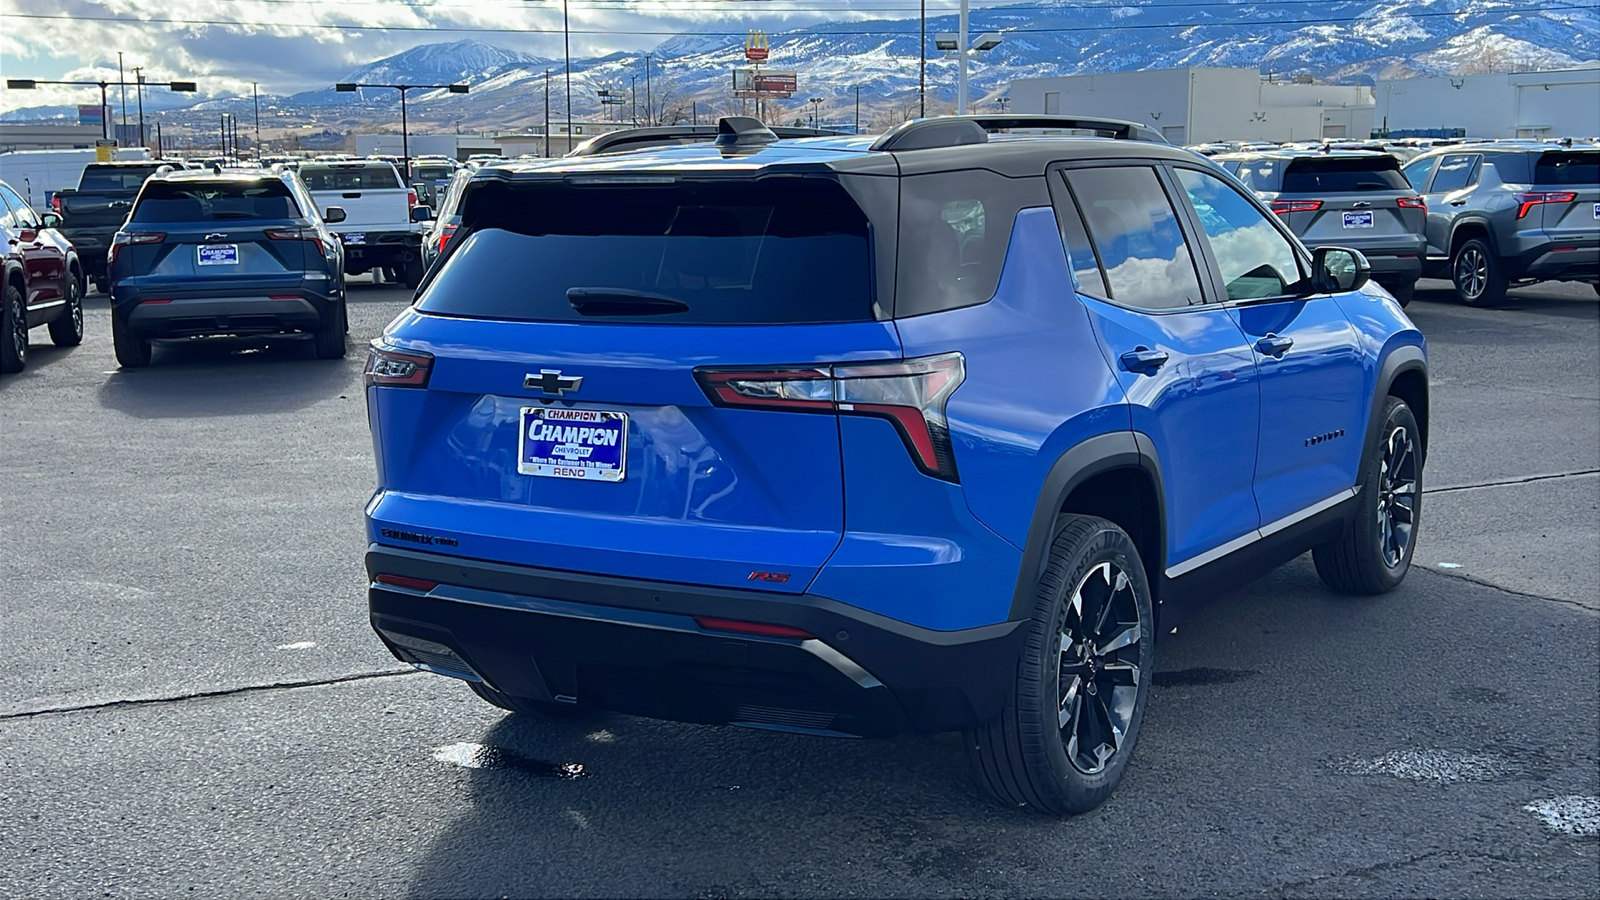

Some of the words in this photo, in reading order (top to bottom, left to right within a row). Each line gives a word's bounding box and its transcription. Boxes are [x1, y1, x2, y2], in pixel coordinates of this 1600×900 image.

[548, 410, 597, 420] CHAMPION
[528, 419, 619, 446] CHAMPION
[554, 446, 589, 456] CHEVROLET
[548, 457, 557, 465] The
[586, 460, 595, 468] The
[553, 467, 586, 477] RENO
[747, 570, 791, 583] RS
[1050, 541, 1104, 671] CONTINENTAL
